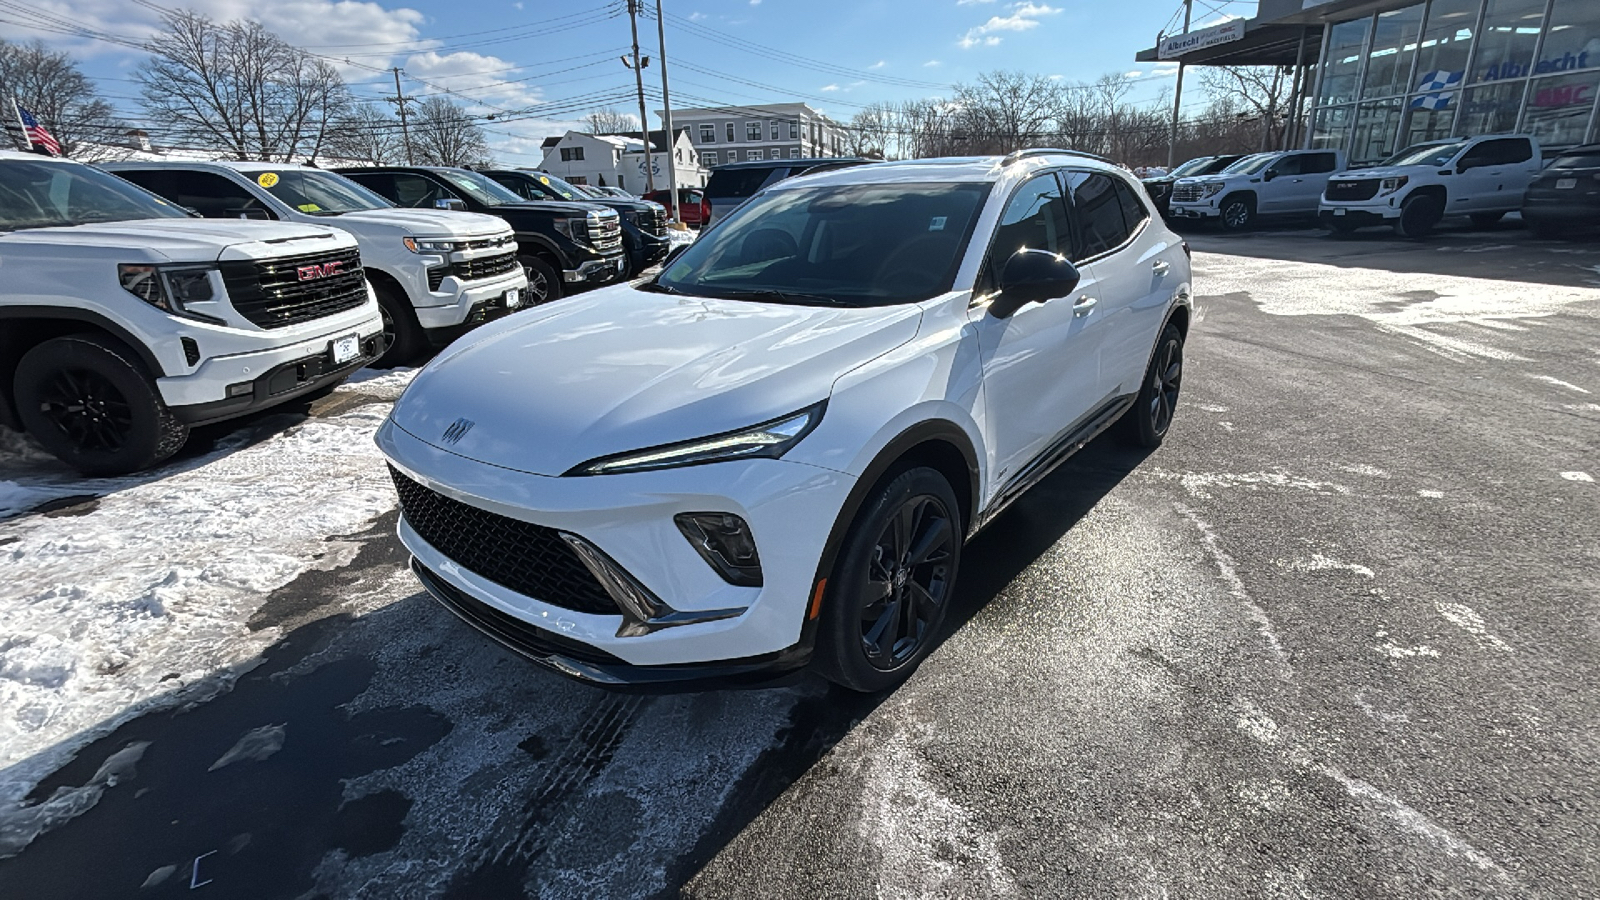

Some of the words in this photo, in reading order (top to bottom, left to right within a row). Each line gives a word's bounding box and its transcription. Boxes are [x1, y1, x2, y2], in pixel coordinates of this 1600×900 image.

[1168, 36, 1199, 51] Albrecht
[1536, 84, 1591, 107] GMC
[297, 261, 344, 281] GMC
